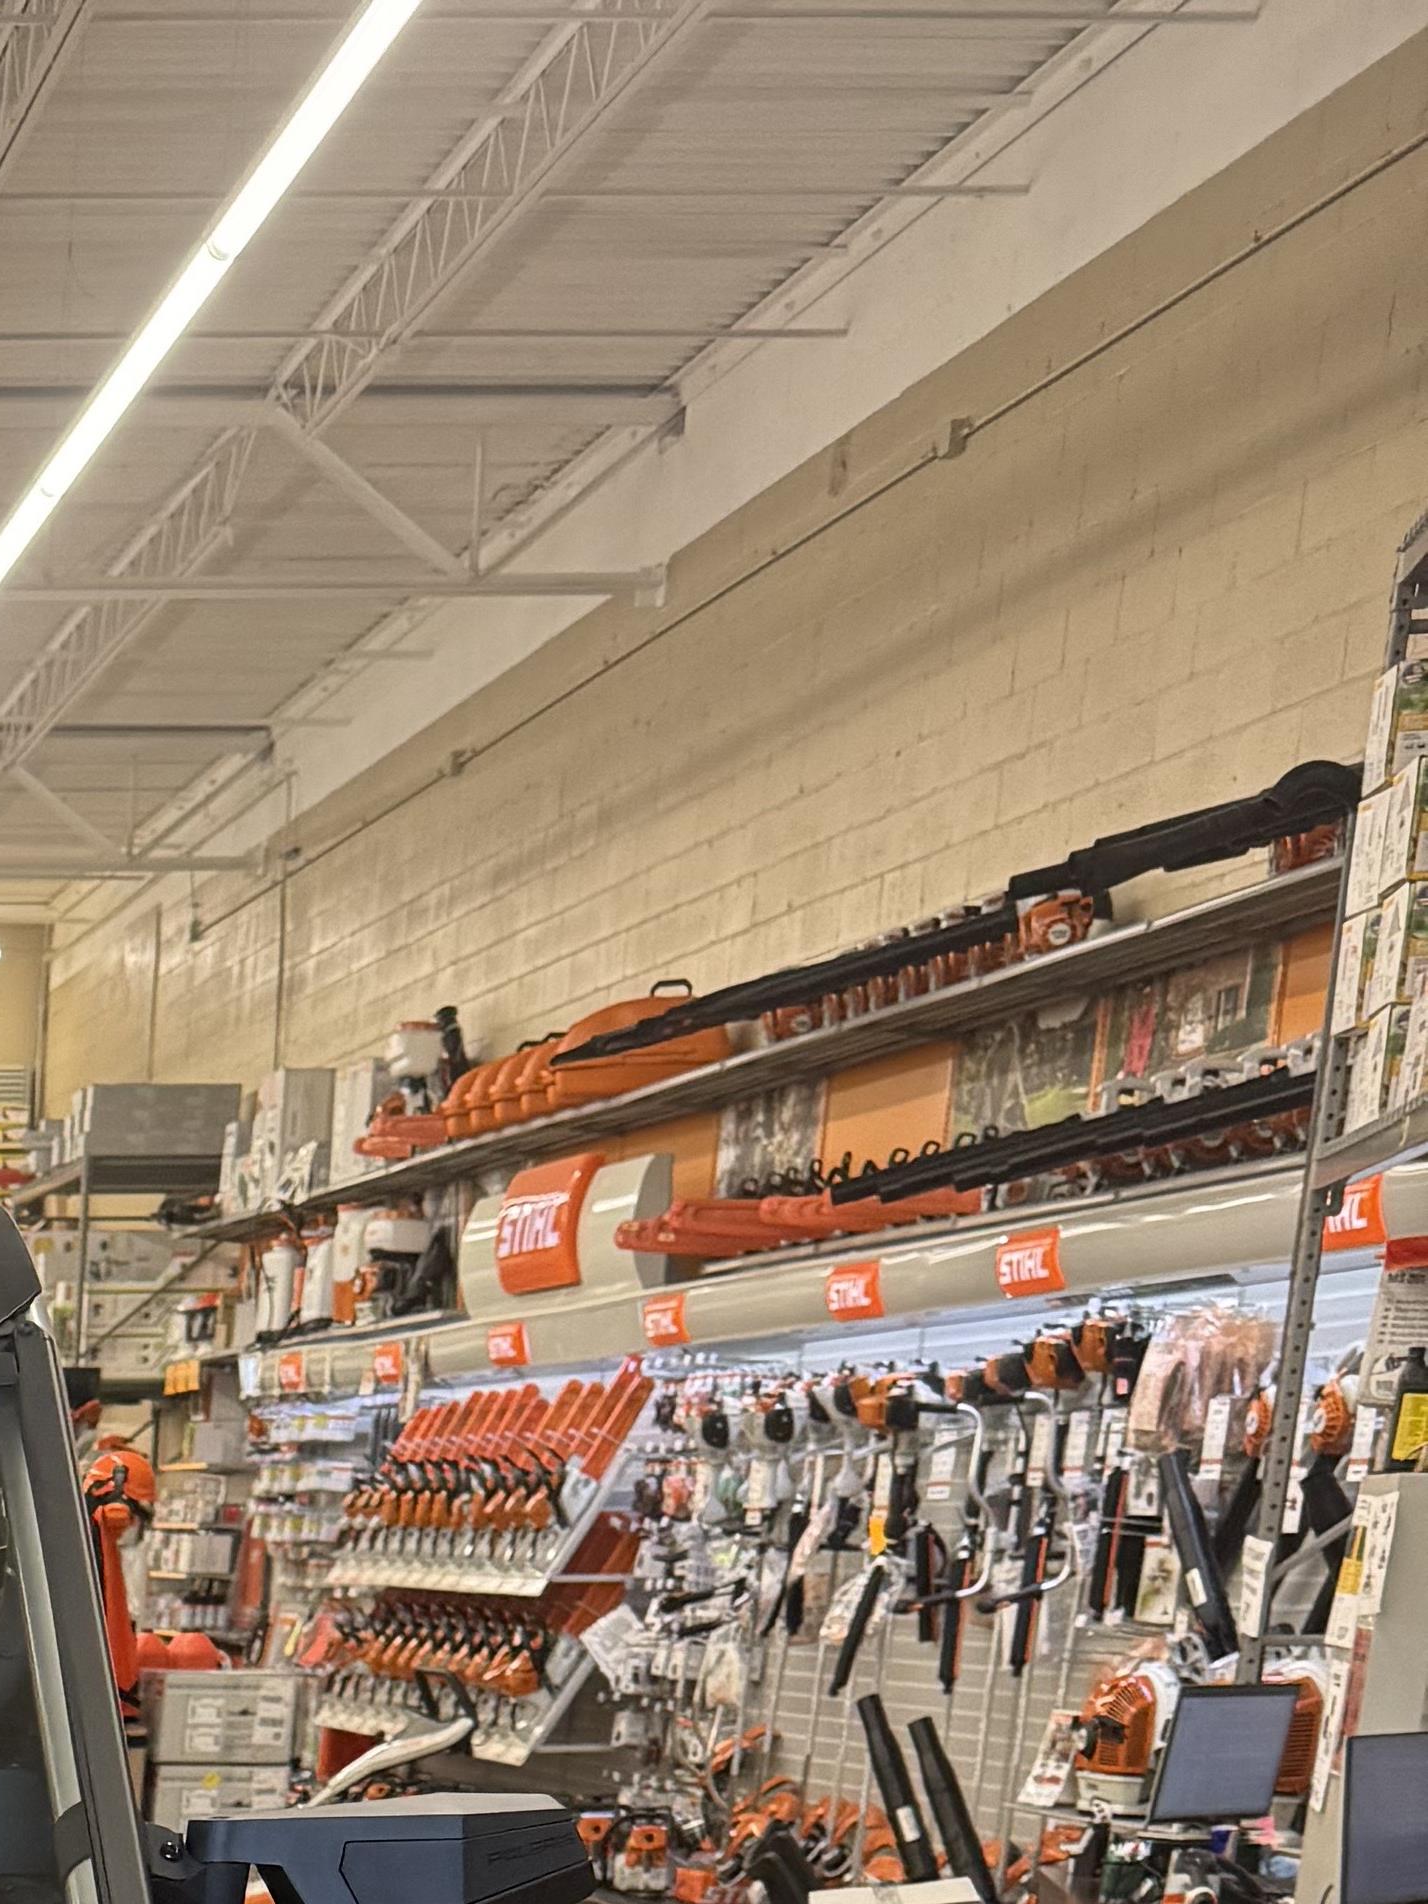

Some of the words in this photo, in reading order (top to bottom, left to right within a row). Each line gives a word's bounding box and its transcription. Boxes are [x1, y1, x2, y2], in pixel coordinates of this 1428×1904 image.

[496, 1202, 562, 1259] STIHL
[998, 1247, 1049, 1285] STIHL
[828, 1277, 872, 1312] STIHL
